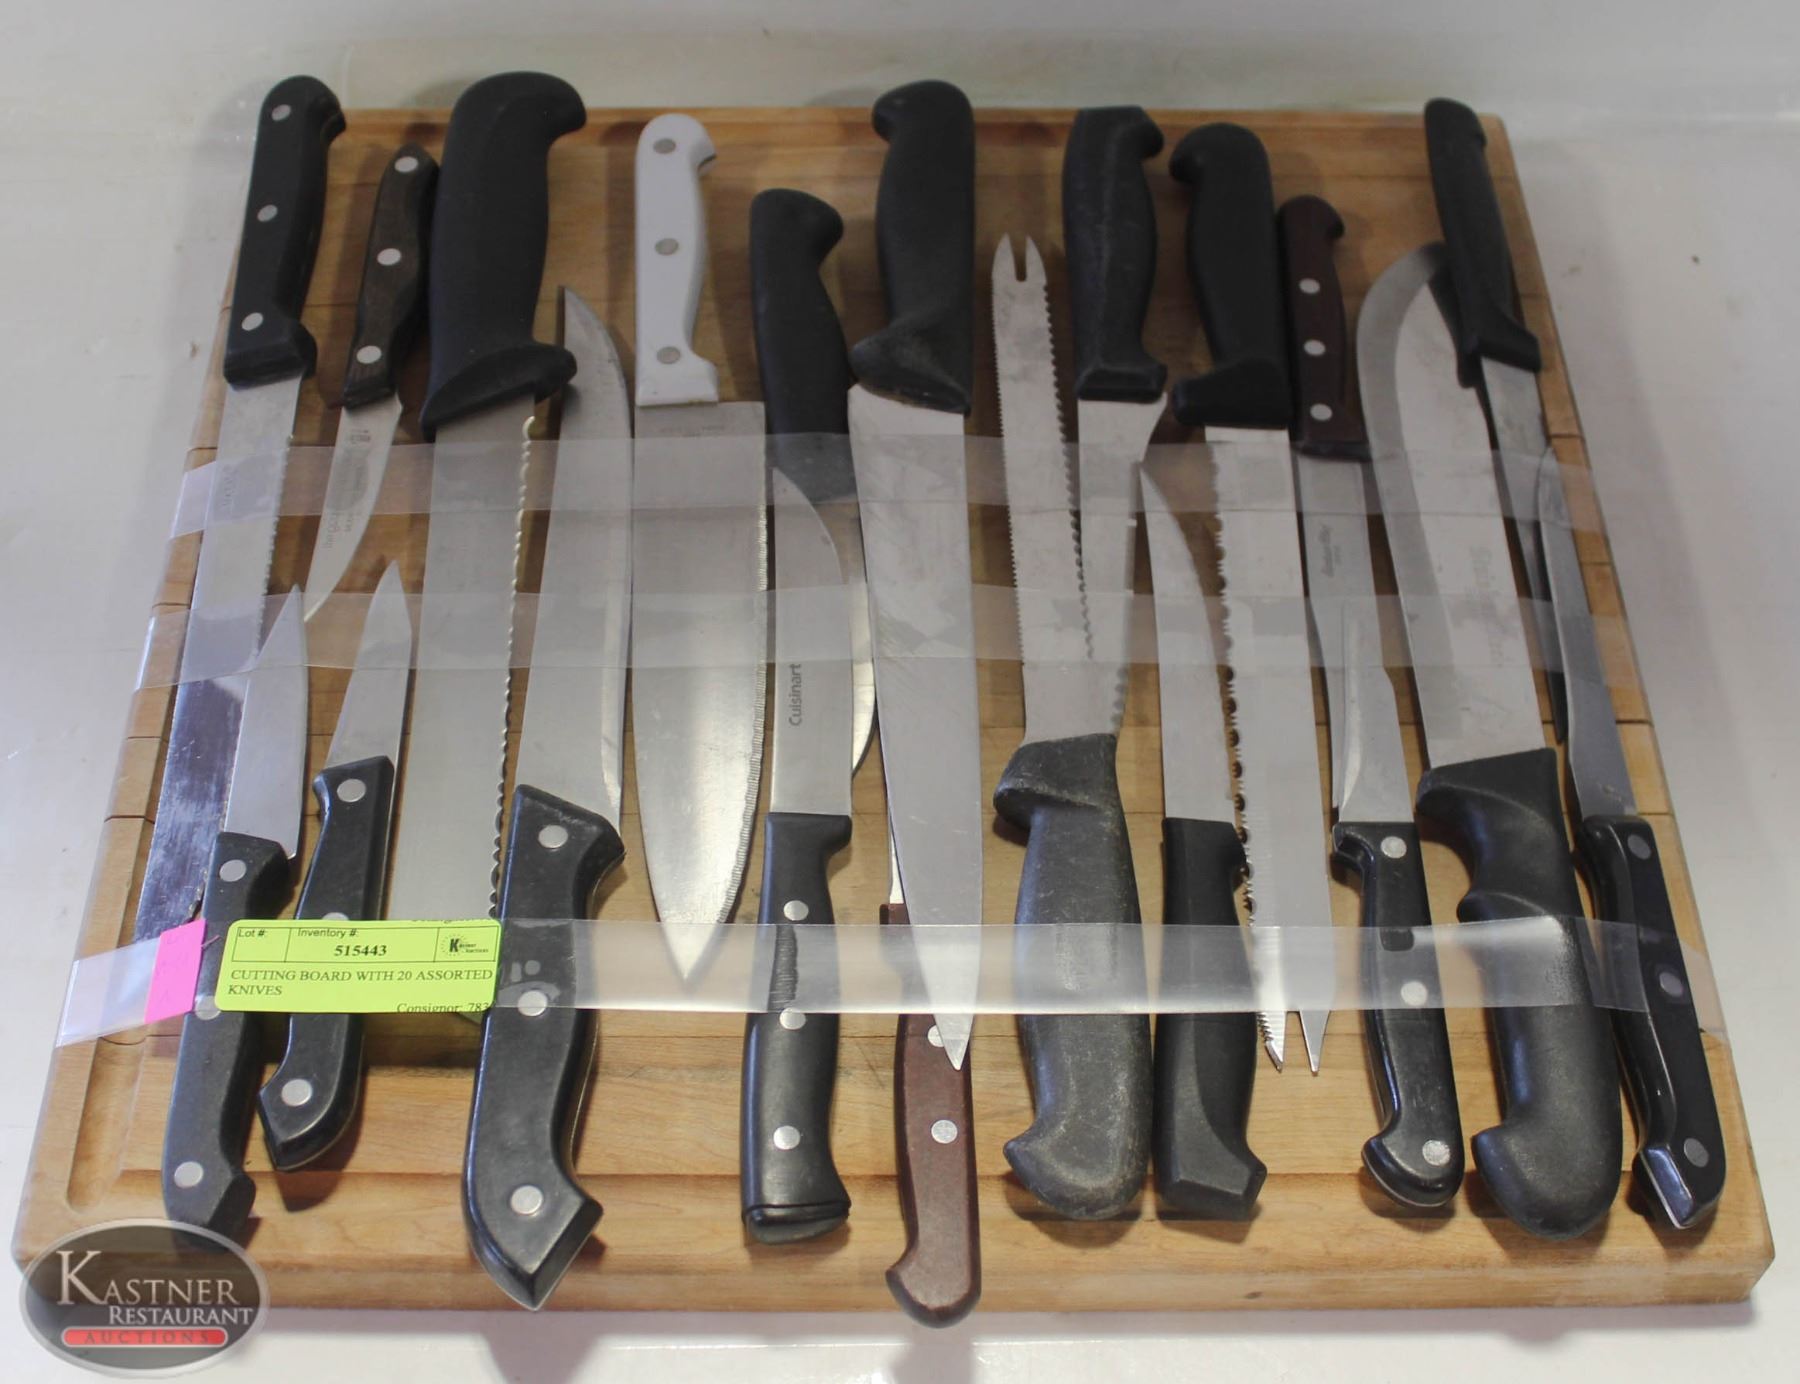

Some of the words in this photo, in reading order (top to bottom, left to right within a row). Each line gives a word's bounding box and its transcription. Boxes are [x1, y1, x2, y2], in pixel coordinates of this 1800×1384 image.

[788, 663, 802, 726] Cuisinart
[238, 929, 255, 937] Lot
[297, 928, 346, 939] Inventory
[333, 944, 387, 956] 515443
[230, 969, 296, 981] CUTTING
[299, 970, 352, 981] BOARD
[355, 970, 395, 981] WITH
[397, 970, 412, 981] 20
[415, 969, 493, 981] ASSORTED
[227, 984, 283, 996] KNIVES
